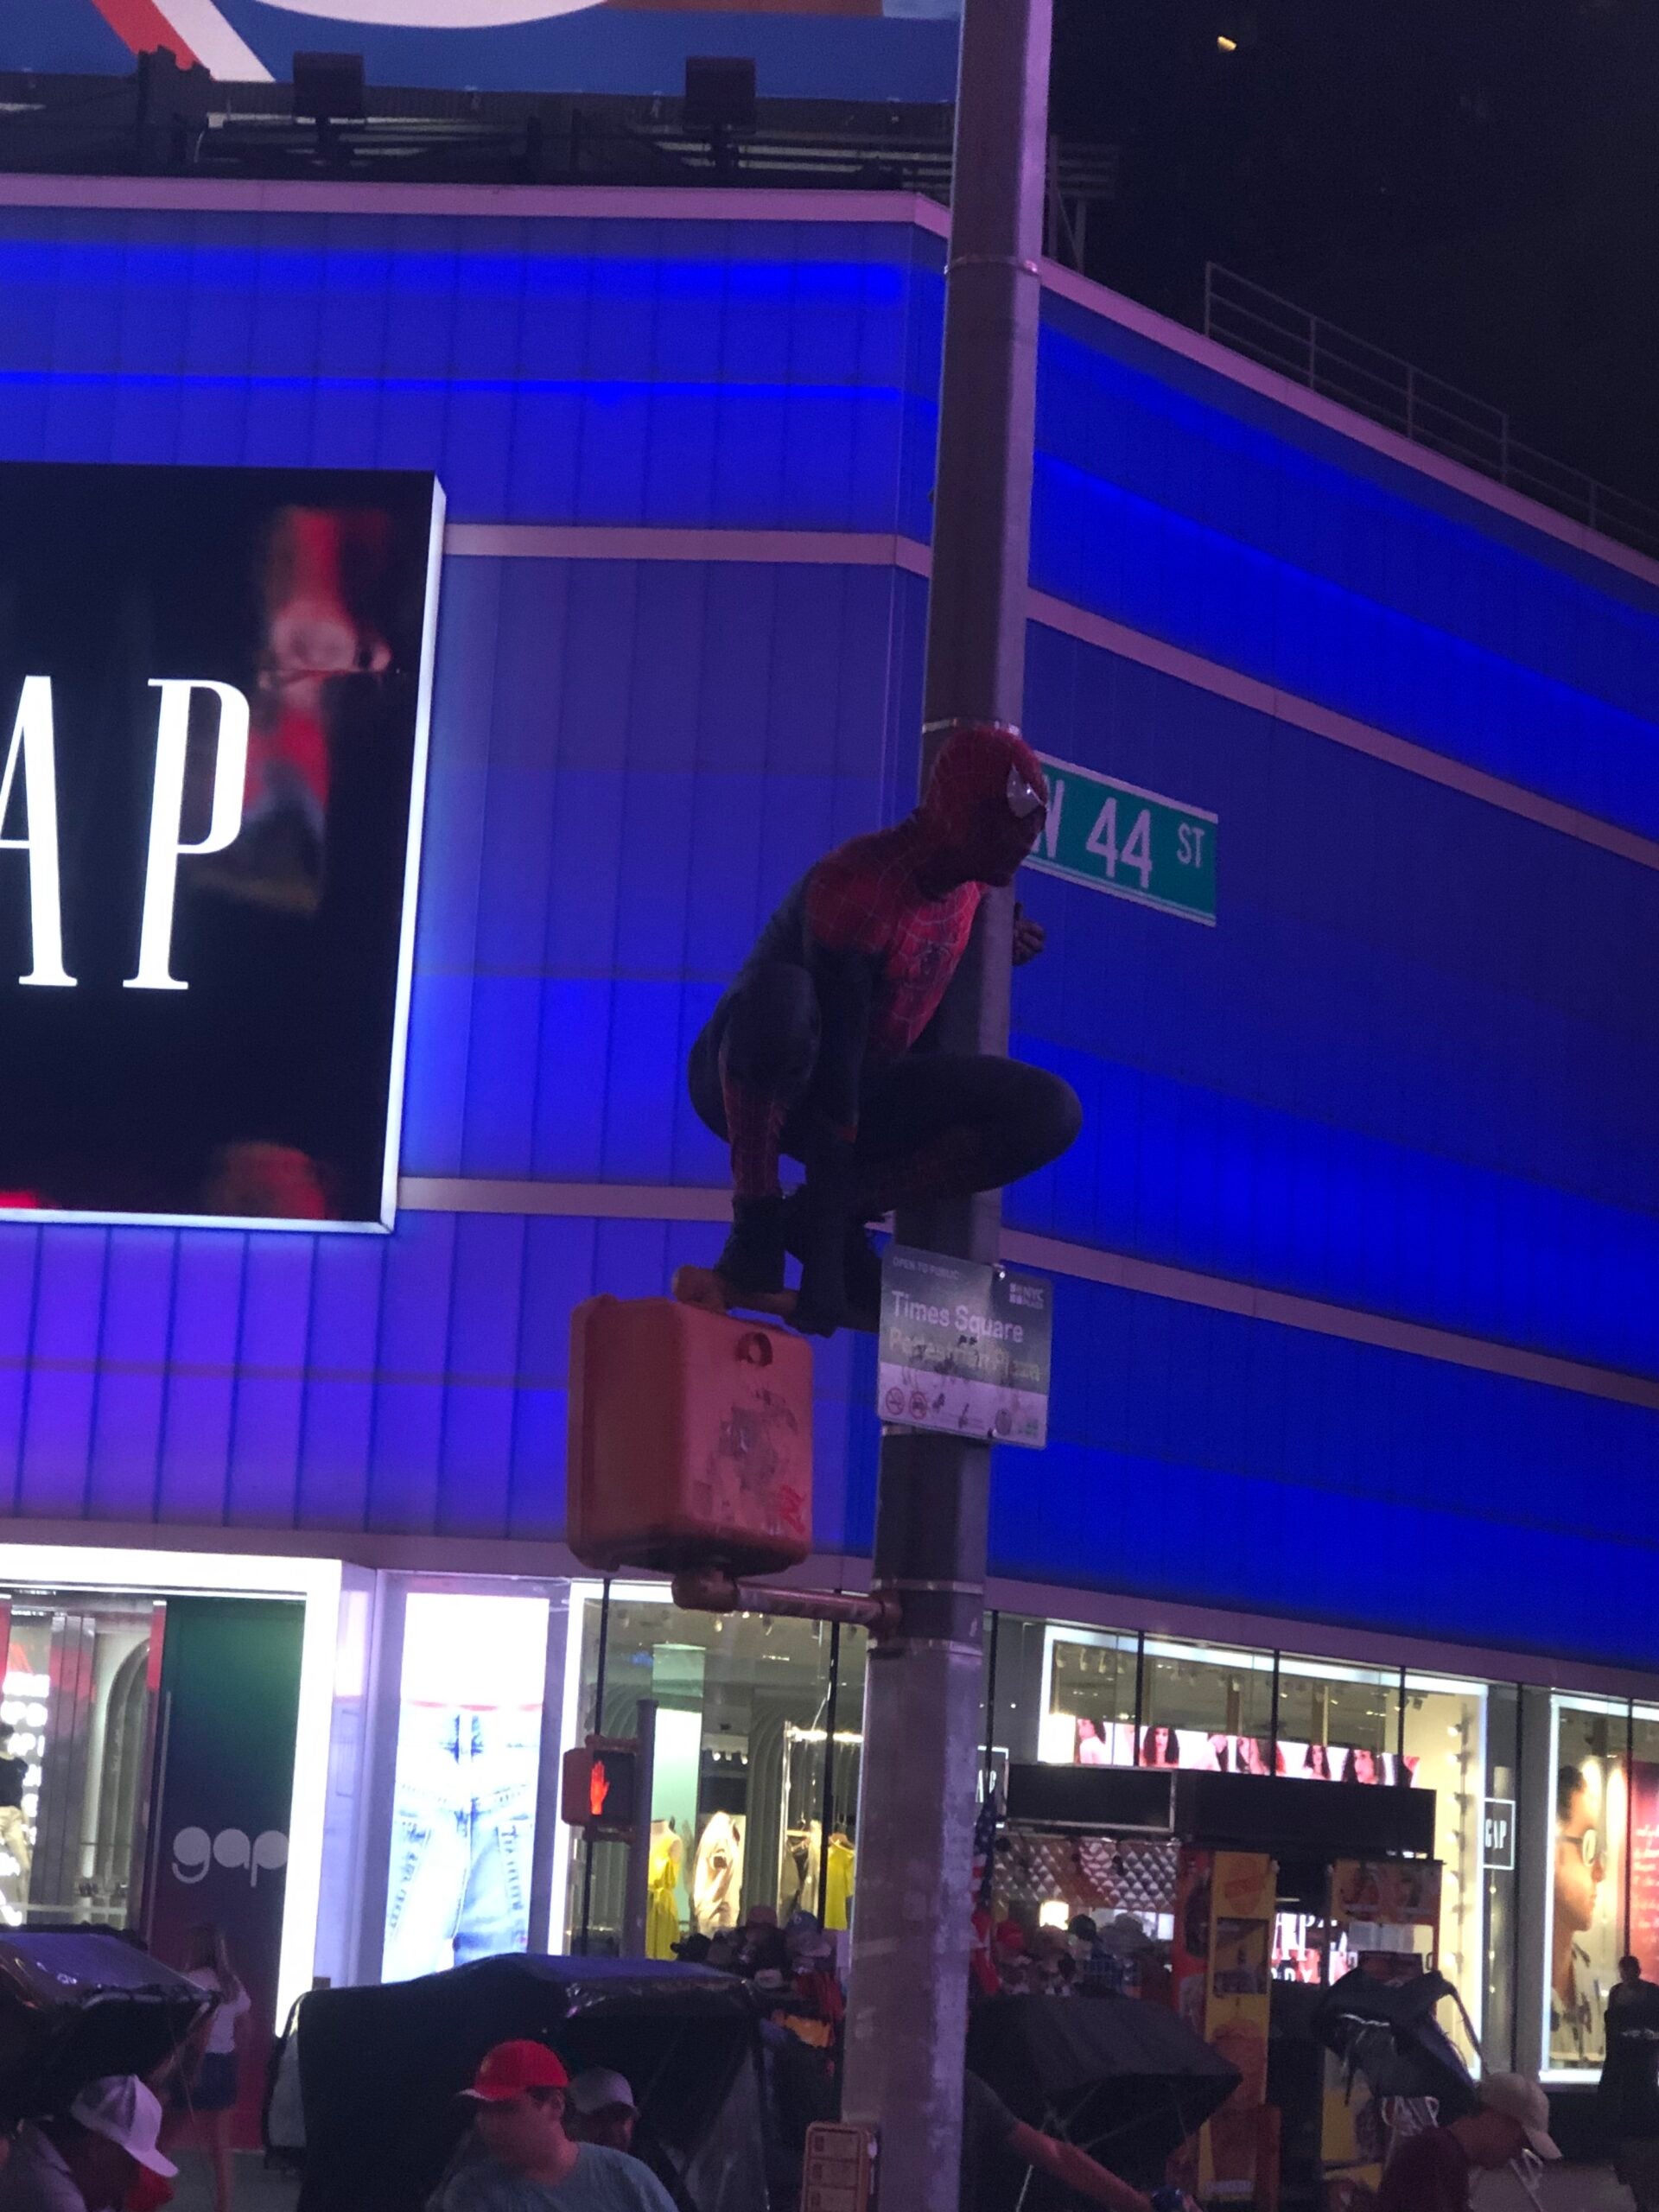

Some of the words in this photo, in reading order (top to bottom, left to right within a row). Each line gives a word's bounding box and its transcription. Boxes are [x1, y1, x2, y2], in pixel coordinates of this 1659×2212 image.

[0, 675, 251, 990] AP
[1086, 797, 1153, 889] 44
[1176, 823, 1205, 869] ST
[892, 1290, 950, 1327] Times
[955, 1304, 1024, 1343] Square
[171, 1826, 289, 1888] gap
[1484, 1818, 1507, 1849] GAP
